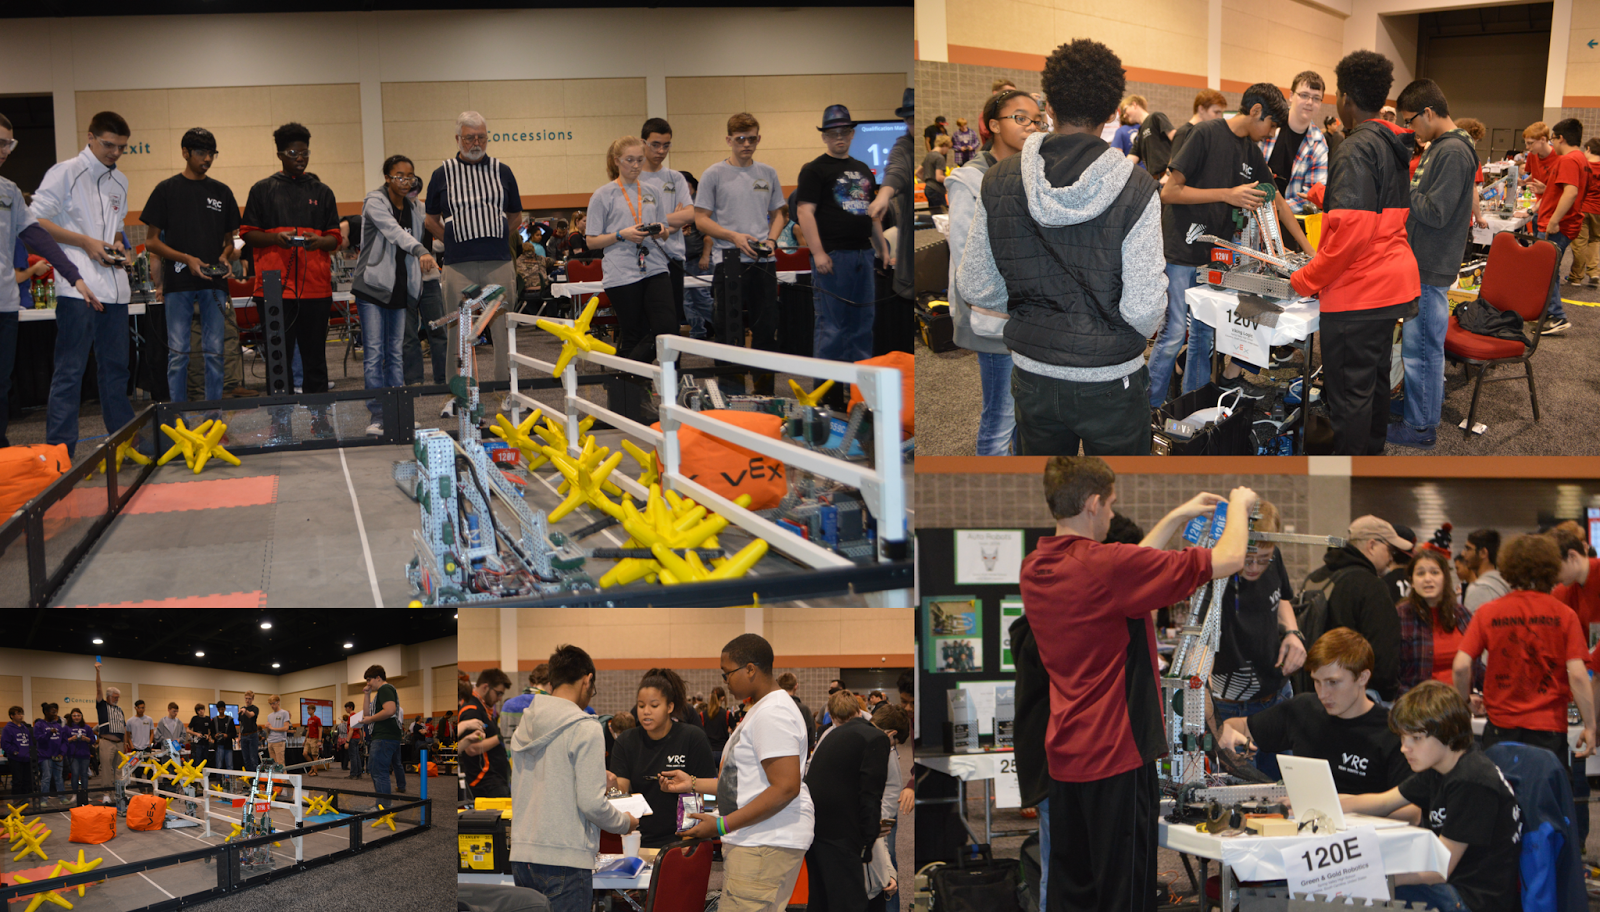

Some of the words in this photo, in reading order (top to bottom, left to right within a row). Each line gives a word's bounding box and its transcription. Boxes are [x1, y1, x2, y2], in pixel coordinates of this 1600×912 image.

[206, 197, 222, 208] VRC
[1214, 251, 1229, 261] 120V
[498, 452, 516, 462] 120V
[720, 457, 783, 487] VEX
[667, 755, 686, 765] VRC
[1341, 752, 1369, 770] VRC
[1301, 836, 1362, 872] 120E
[1300, 877, 1320, 887] Green
[1327, 871, 1342, 879] Gold
[1342, 862, 1370, 875] Robotics
